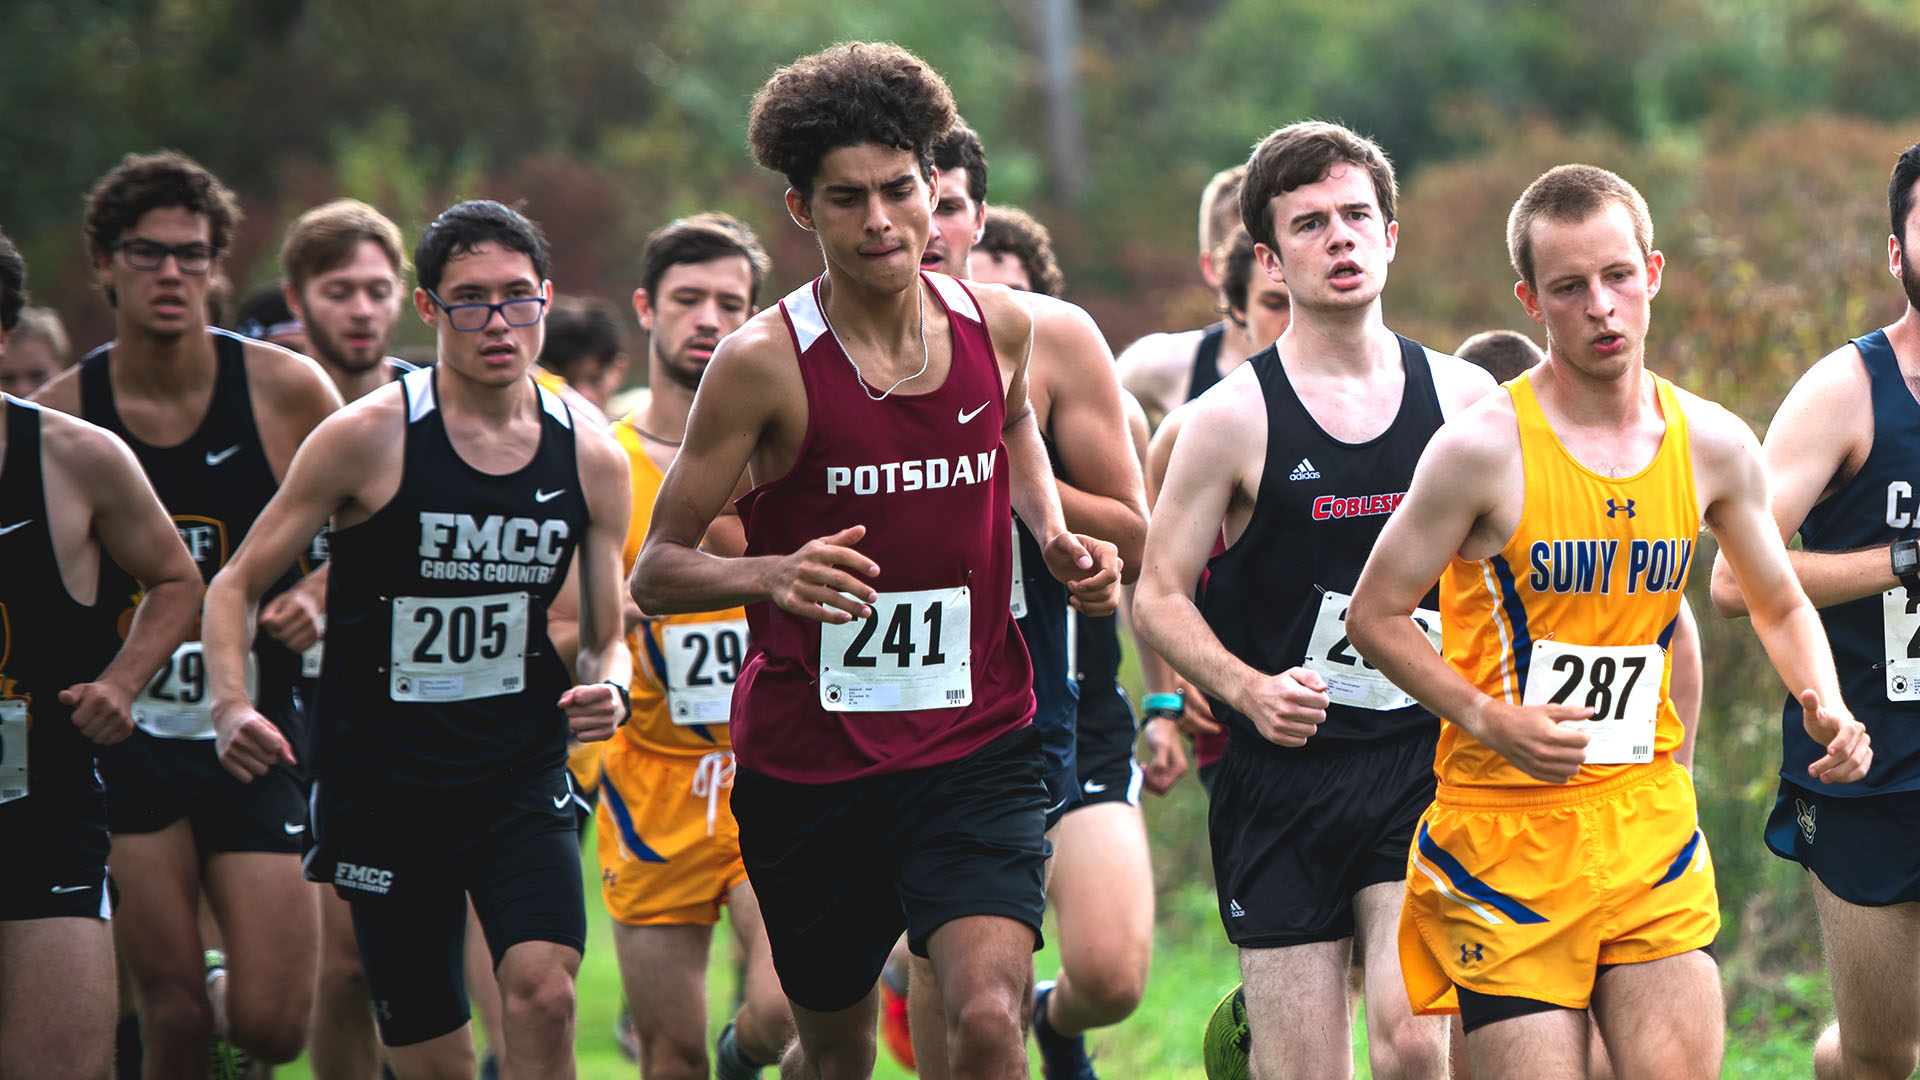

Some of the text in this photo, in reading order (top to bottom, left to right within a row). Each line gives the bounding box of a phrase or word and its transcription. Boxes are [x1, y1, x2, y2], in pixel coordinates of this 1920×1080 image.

[826, 448, 997, 496] POTSDAM
[1289, 471, 1321, 481] adidas
[418, 511, 570, 565] FMCC
[1529, 537, 1692, 595] SUNY POLY
[420, 559, 480, 581] CROSS
[412, 603, 509, 664] 205
[682, 628, 752, 687] 29
[843, 601, 945, 667] 241
[1547, 654, 1647, 722] 287
[335, 861, 393, 887] FMCC
